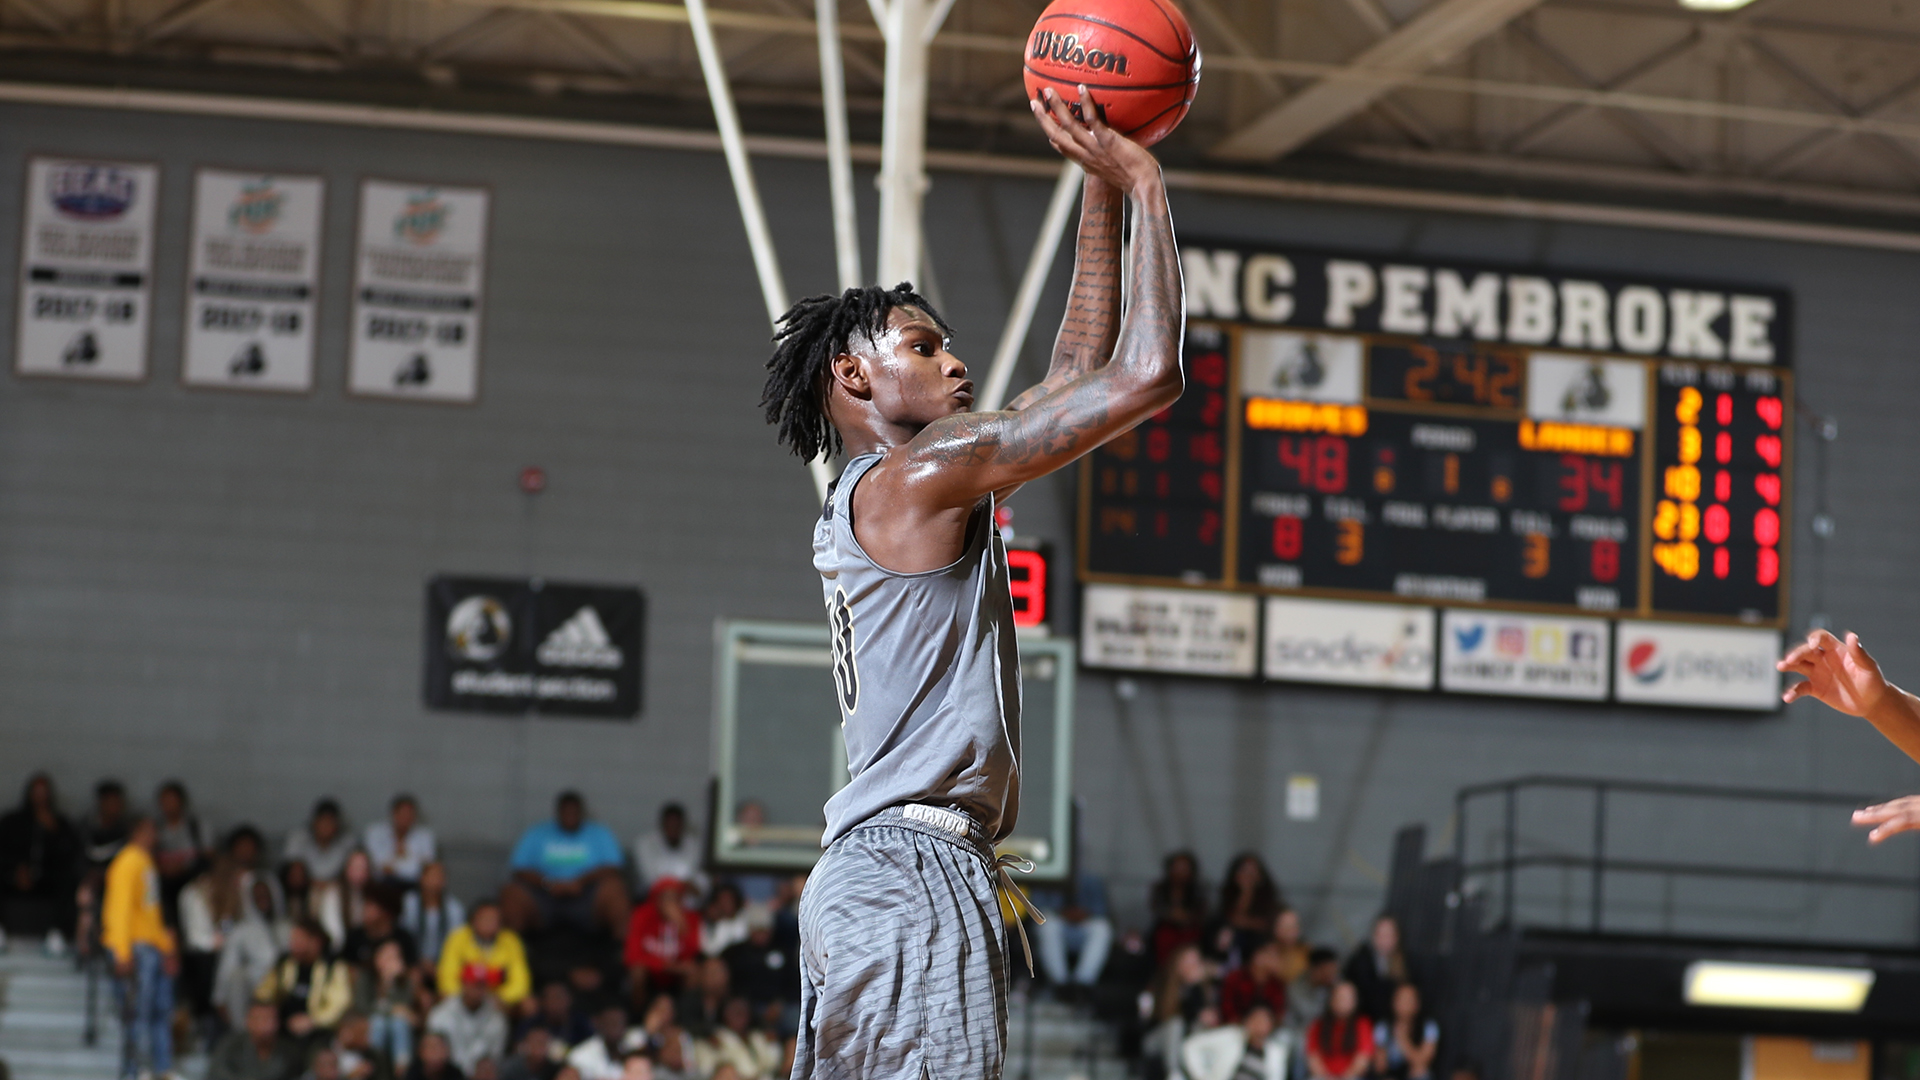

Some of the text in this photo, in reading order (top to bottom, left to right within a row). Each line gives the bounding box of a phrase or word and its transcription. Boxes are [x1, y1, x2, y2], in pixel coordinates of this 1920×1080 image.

[1032, 30, 1129, 77] Wilson
[31, 293, 136, 325] 2017-18
[197, 303, 303, 336] 2017-18
[1182, 247, 1296, 322] NC
[1325, 260, 1777, 363] PEMBROKE
[364, 314, 468, 347] 2017-18
[1675, 386, 1783, 430] 2 1 4
[1278, 436, 1349, 494] 48
[1715, 431, 1732, 465] 1
[1755, 434, 1782, 468] 4
[1443, 453, 1459, 495] 1
[1559, 454, 1623, 512] 34
[1714, 469, 1732, 503] 1
[1754, 472, 1781, 506] 4
[1653, 499, 1700, 541] 23
[1335, 518, 1364, 566] 3
[1522, 534, 1551, 579] 3
[1713, 546, 1731, 581] 1
